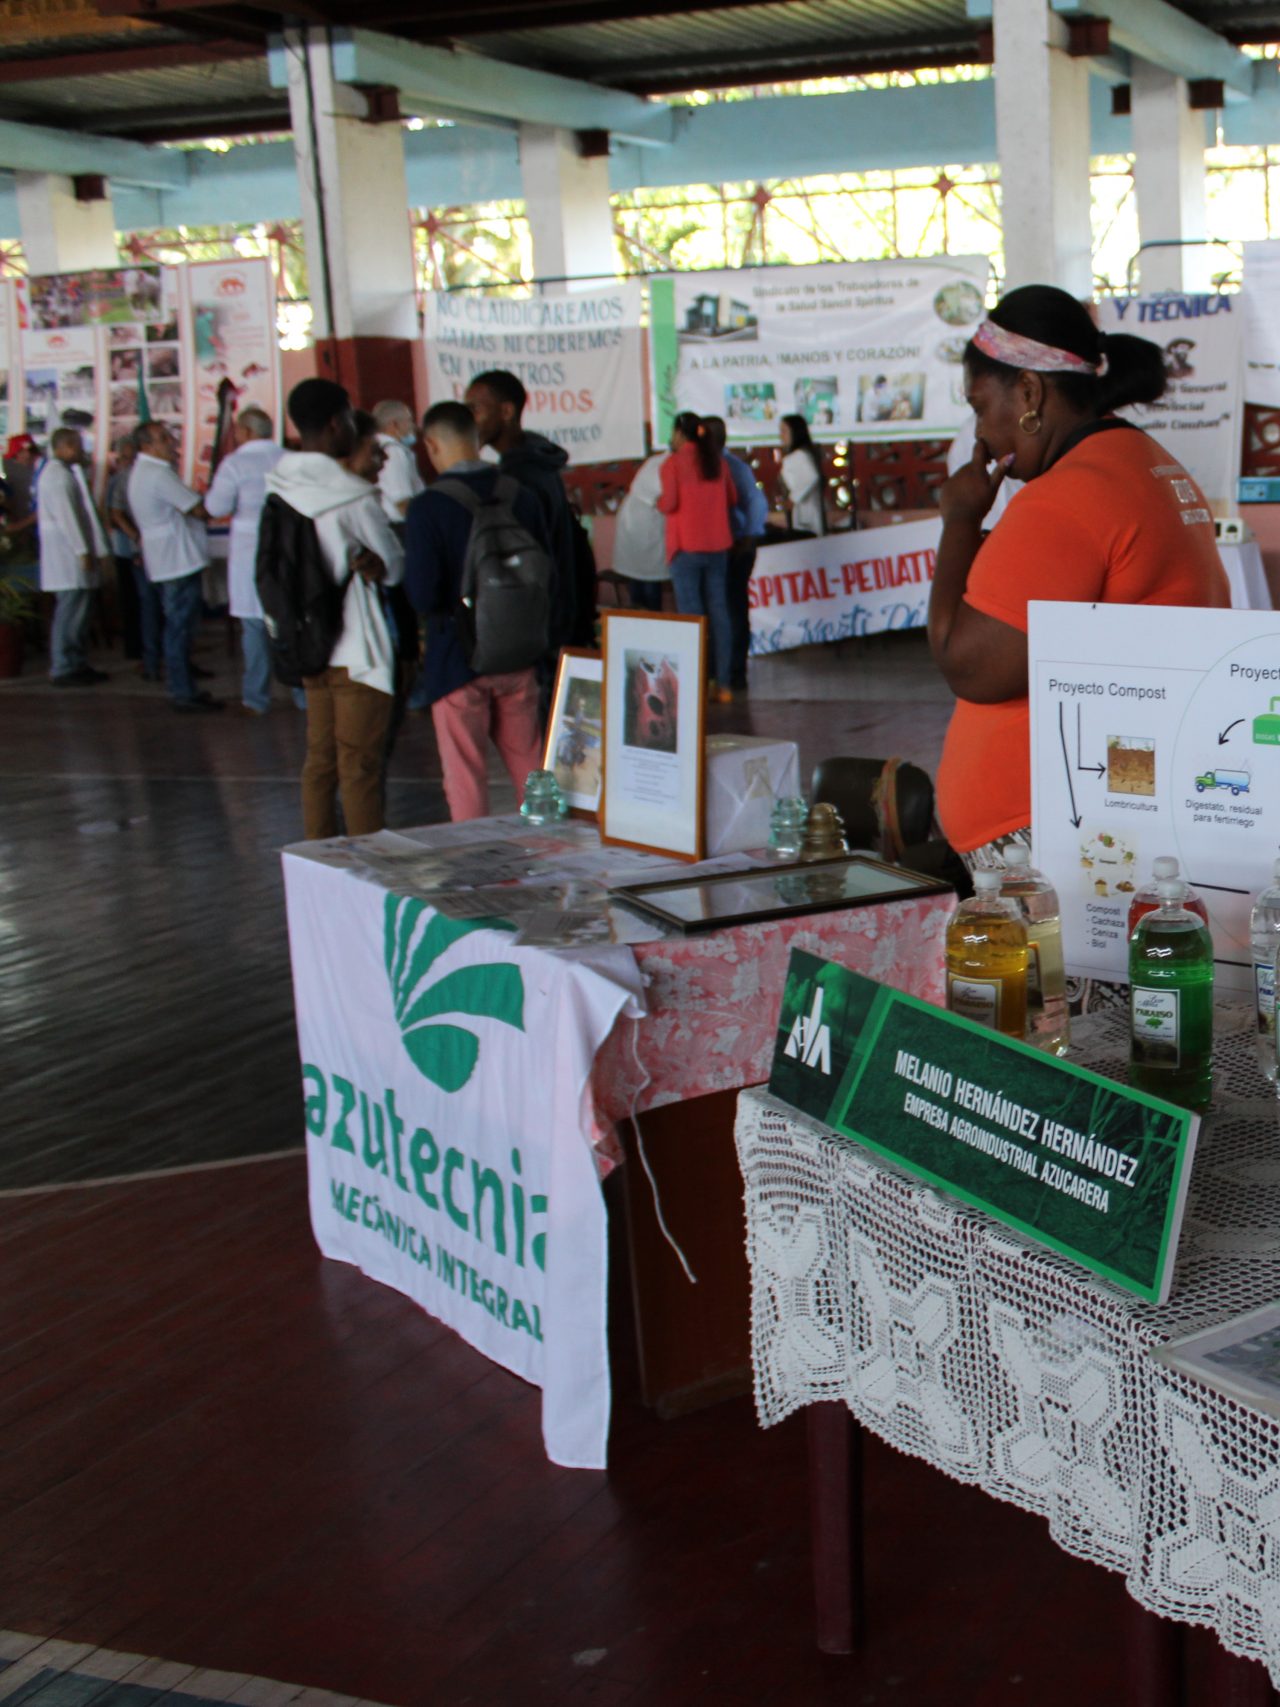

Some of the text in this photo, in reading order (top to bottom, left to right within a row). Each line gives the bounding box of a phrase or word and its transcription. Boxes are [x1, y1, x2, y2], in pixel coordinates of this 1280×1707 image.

[436, 292, 624, 328] NO CLAUDICAREMOS
[1113, 299, 1130, 321] Y
[439, 351, 461, 376] EN
[690, 358, 699, 370] A
[703, 356, 721, 370] LA
[836, 350, 843, 362] Y
[1049, 678, 1167, 700] Proyecto Compost
[1104, 798, 1158, 813] Lombricultura
[1229, 803, 1263, 817] residual
[1193, 814, 1212, 825] para
[893, 1049, 1139, 1188] MELANIO HERNÁNDEZ HERNÁNDEZ
[903, 1092, 1110, 1214] EMPRESA AGROINDUSTRIAL AZUCARERA
[436, 1243, 545, 1344] INTEGRAL
